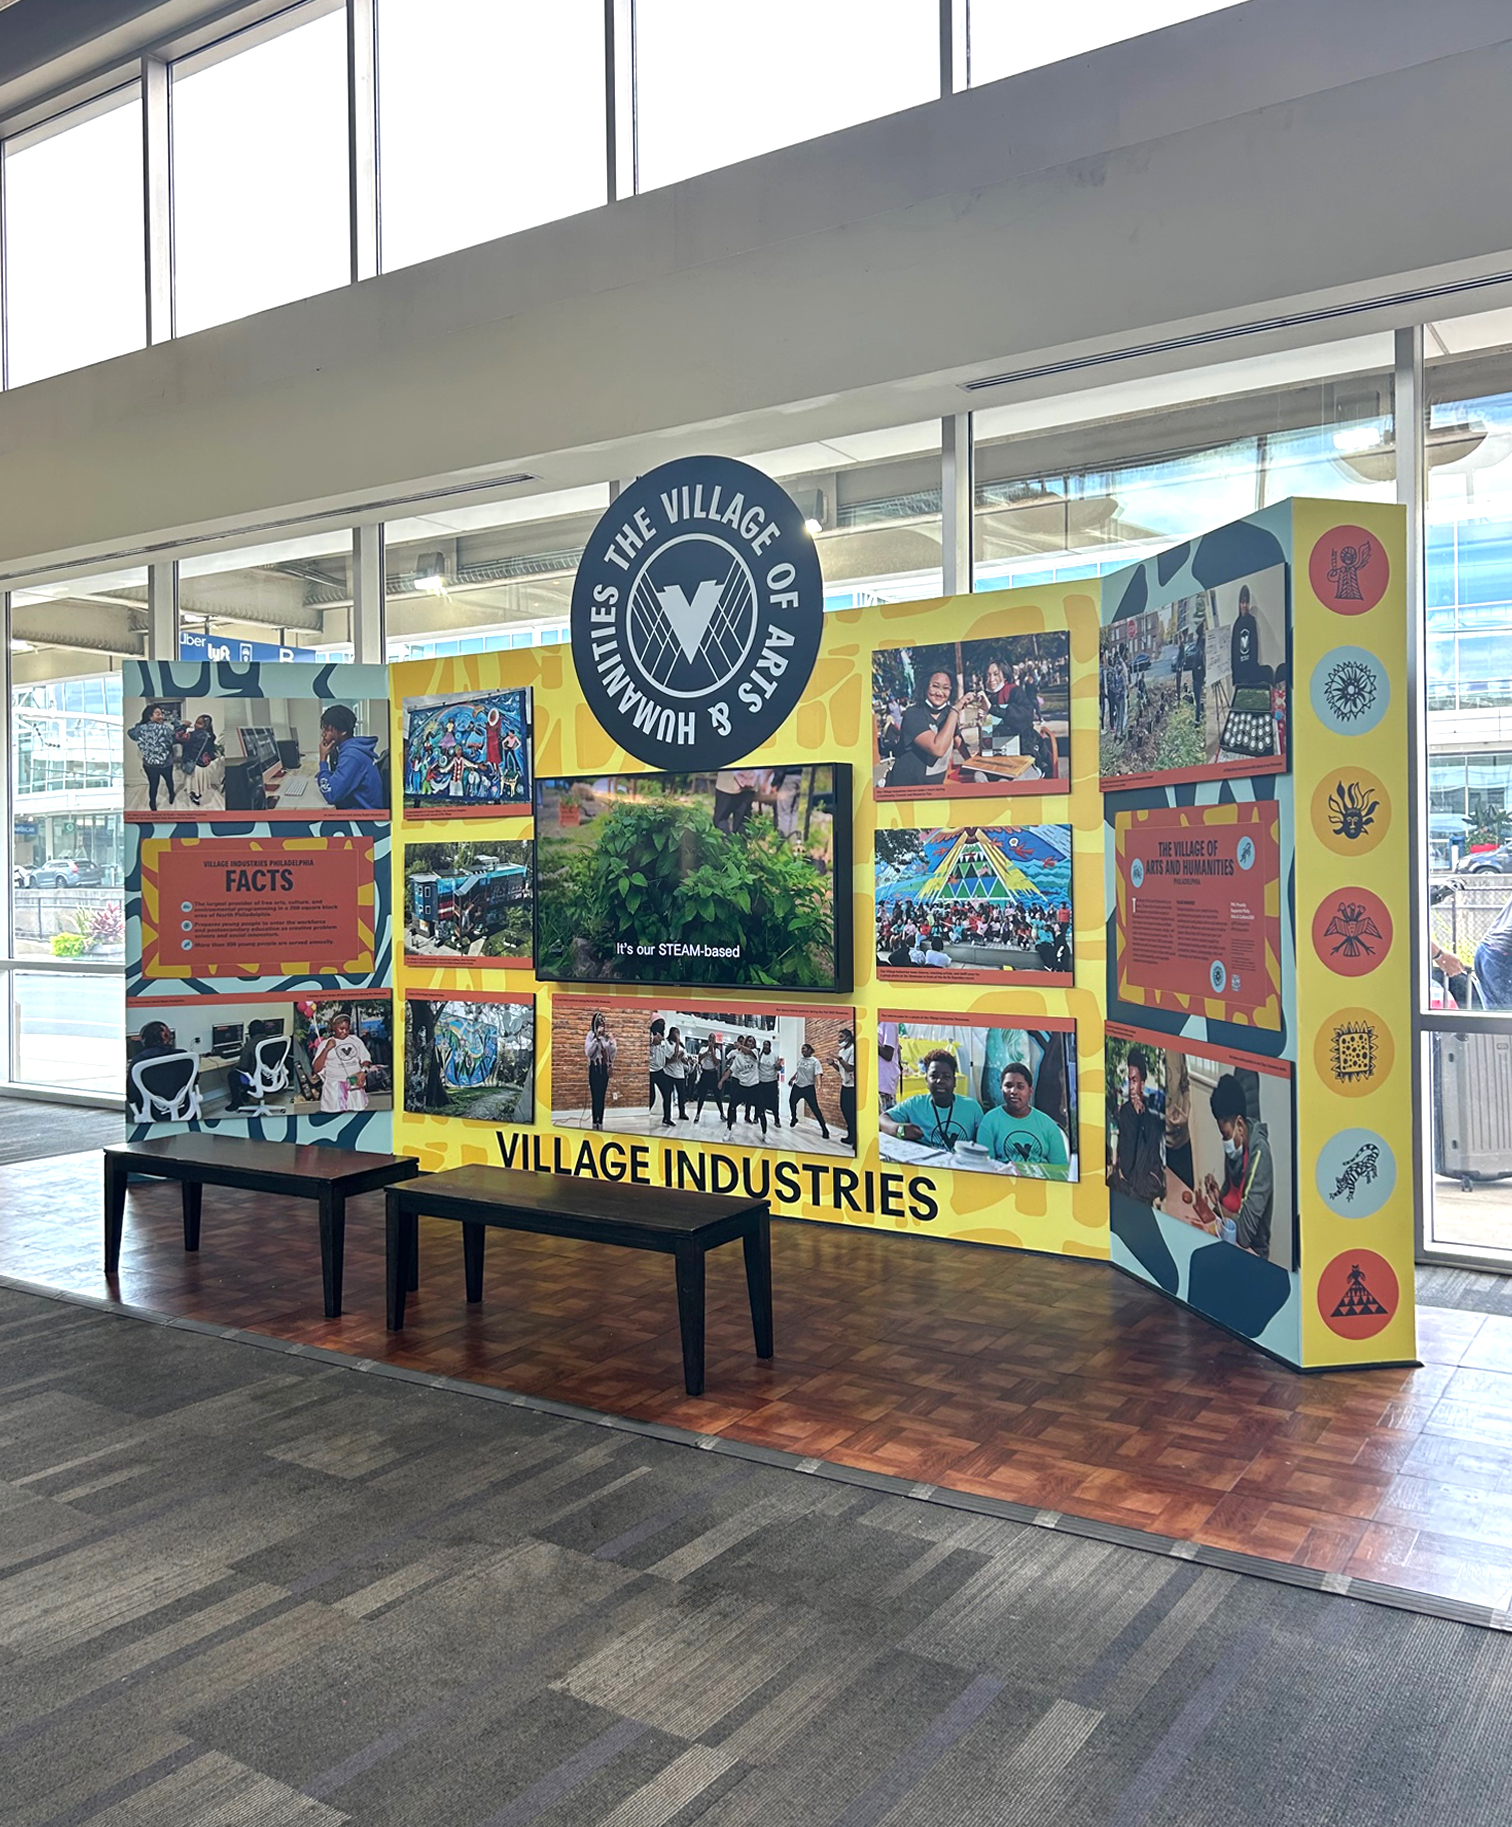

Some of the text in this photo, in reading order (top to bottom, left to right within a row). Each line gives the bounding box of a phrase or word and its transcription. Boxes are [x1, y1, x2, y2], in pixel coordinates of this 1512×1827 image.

[590, 484, 799, 745] THE VILLAGE OF ARTS & HUMANITIES
[1158, 840, 1218, 857] THE VILLAGE OF
[1146, 859, 1234, 876] ARTS AND HUMANITIES
[226, 868, 293, 892] FACTS
[636, 945, 655, 956] our
[658, 943, 740, 958] STEAM-based
[496, 1131, 939, 1222] VILLAGE INDUSTRIES
